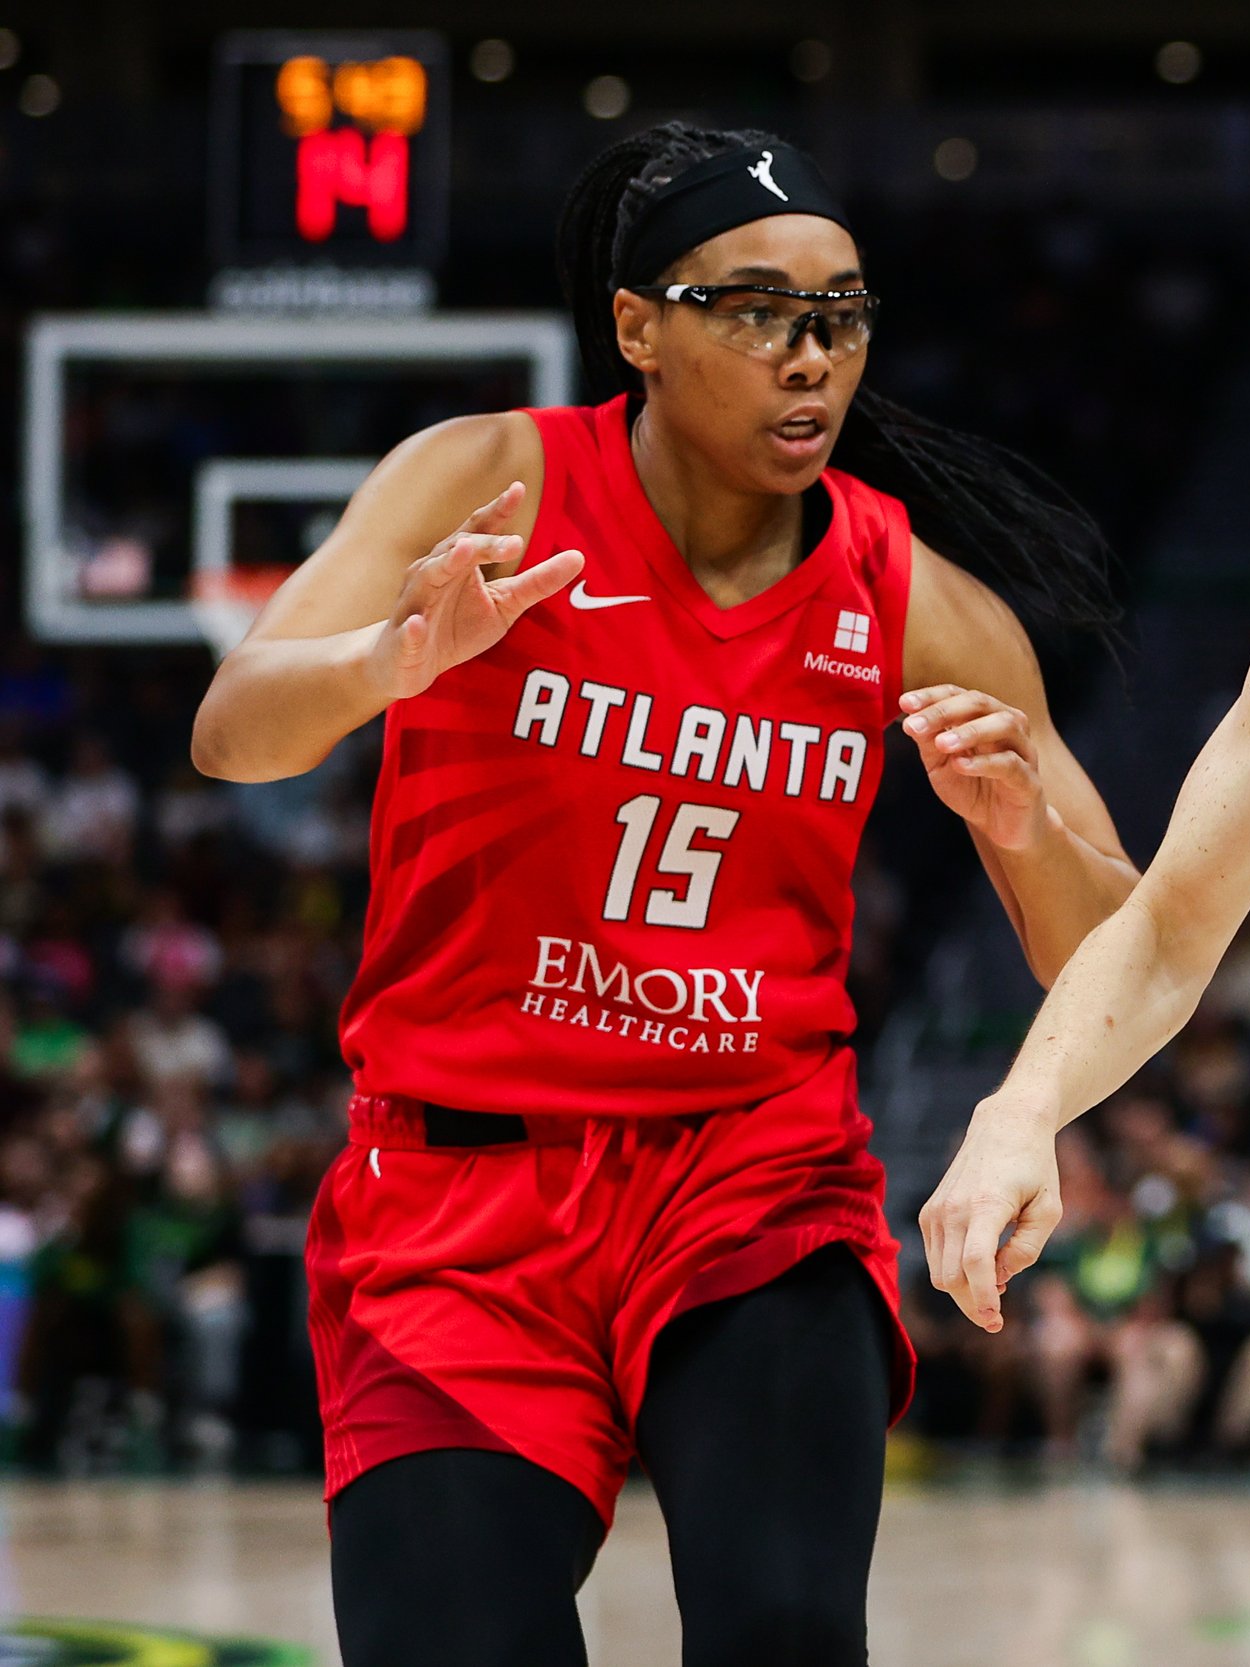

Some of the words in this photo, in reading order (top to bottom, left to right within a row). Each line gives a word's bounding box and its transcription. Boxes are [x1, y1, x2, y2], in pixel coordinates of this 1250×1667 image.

[803, 651, 881, 685] Microsoft
[512, 667, 868, 803] ATLANTA
[602, 793, 742, 930] 15
[520, 992, 759, 1053] HEALTHCARE
[528, 936, 765, 1023] EMORY
